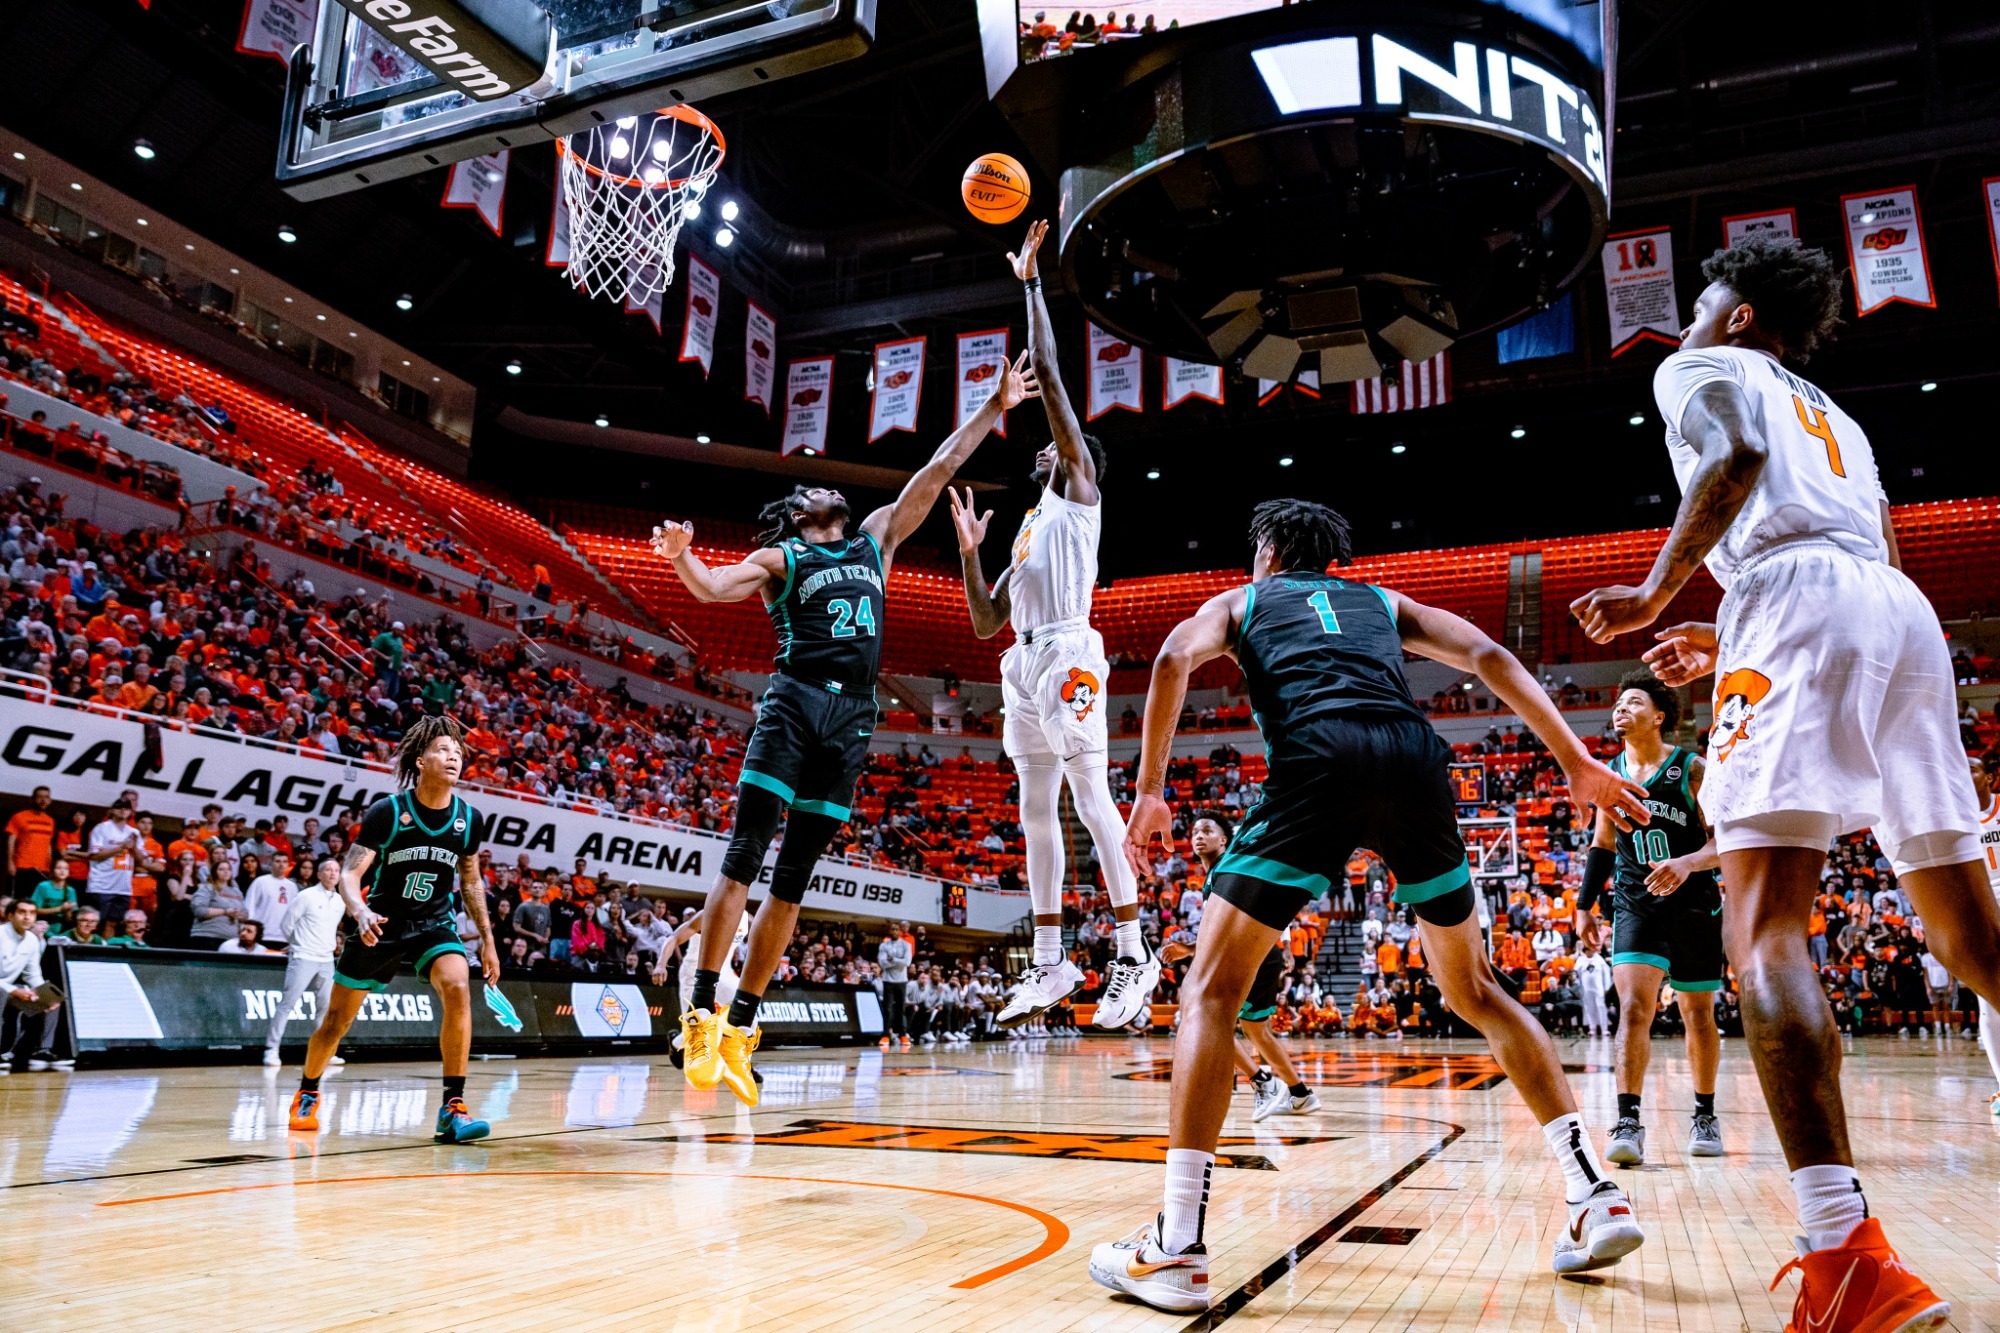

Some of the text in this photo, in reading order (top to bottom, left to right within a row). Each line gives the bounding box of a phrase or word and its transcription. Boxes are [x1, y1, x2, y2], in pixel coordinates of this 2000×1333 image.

[973, 164, 1011, 184] Wilson
[1864, 199, 1896, 210] NCAA
[1872, 267, 1908, 278] COWBOY
[1875, 256, 1903, 269] 1935
[1871, 275, 1914, 285] WRESTLING
[1791, 393, 1847, 479] 4
[799, 567, 843, 605] NORTH
[1281, 579, 1345, 590] SCOTT
[828, 596, 876, 638] 24
[1306, 590, 1342, 634] 1
[1460, 779, 1478, 801] 16
[387, 846, 459, 869] NORTH TEXA
[574, 832, 703, 877] ARENA
[1632, 828, 1671, 865] 10
[402, 871, 439, 902] 15
[862, 882, 903, 905] 1938
[811, 1003, 848, 1023] STATE
